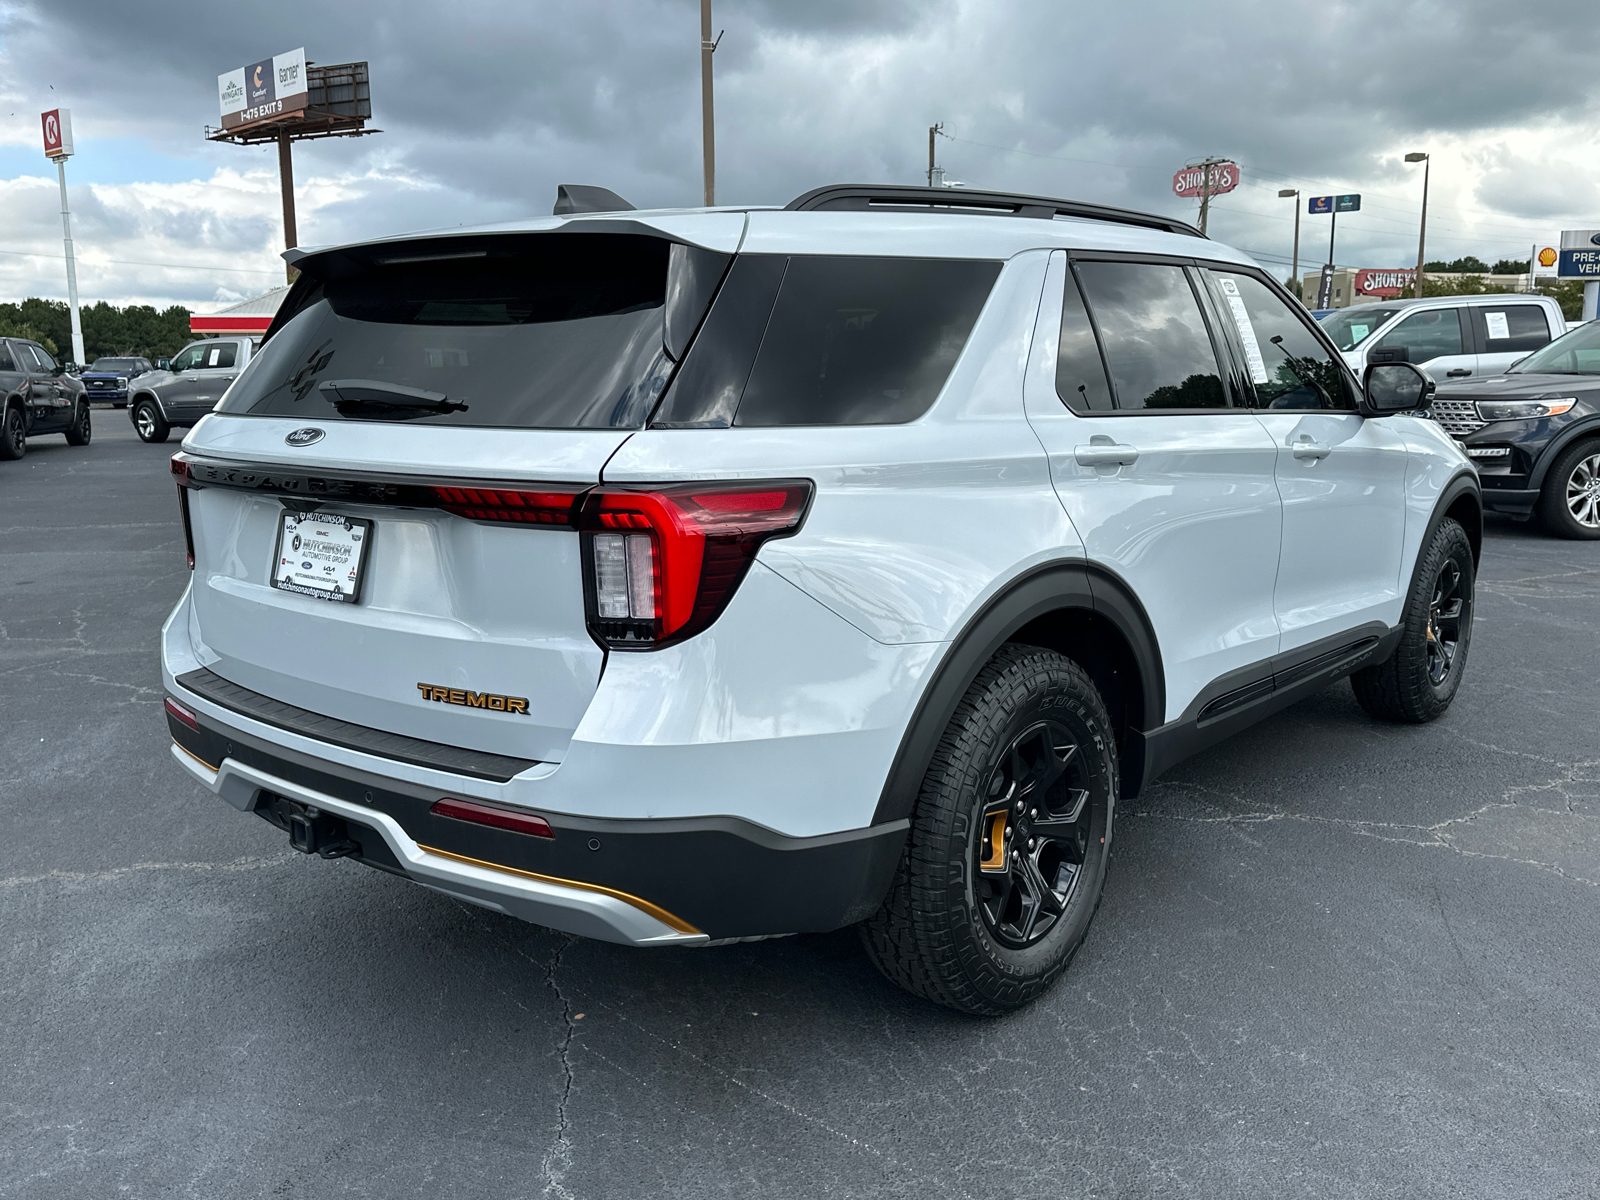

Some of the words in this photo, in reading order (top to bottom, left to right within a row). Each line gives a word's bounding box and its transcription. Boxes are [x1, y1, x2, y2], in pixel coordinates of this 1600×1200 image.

[221, 87, 243, 100] WINGATE
[241, 107, 258, 121] I-475
[259, 102, 276, 116] EXIT
[277, 100, 283, 111] 9
[48, 120, 57, 140] K
[1572, 252, 1600, 262] PRE-
[306, 512, 346, 525] HUTCHINSON
[302, 539, 352, 556] HUTCHINSON
[302, 551, 331, 561] AUTOMOTIVE
[332, 556, 349, 564] GROUP
[417, 682, 531, 715] TREMOR
